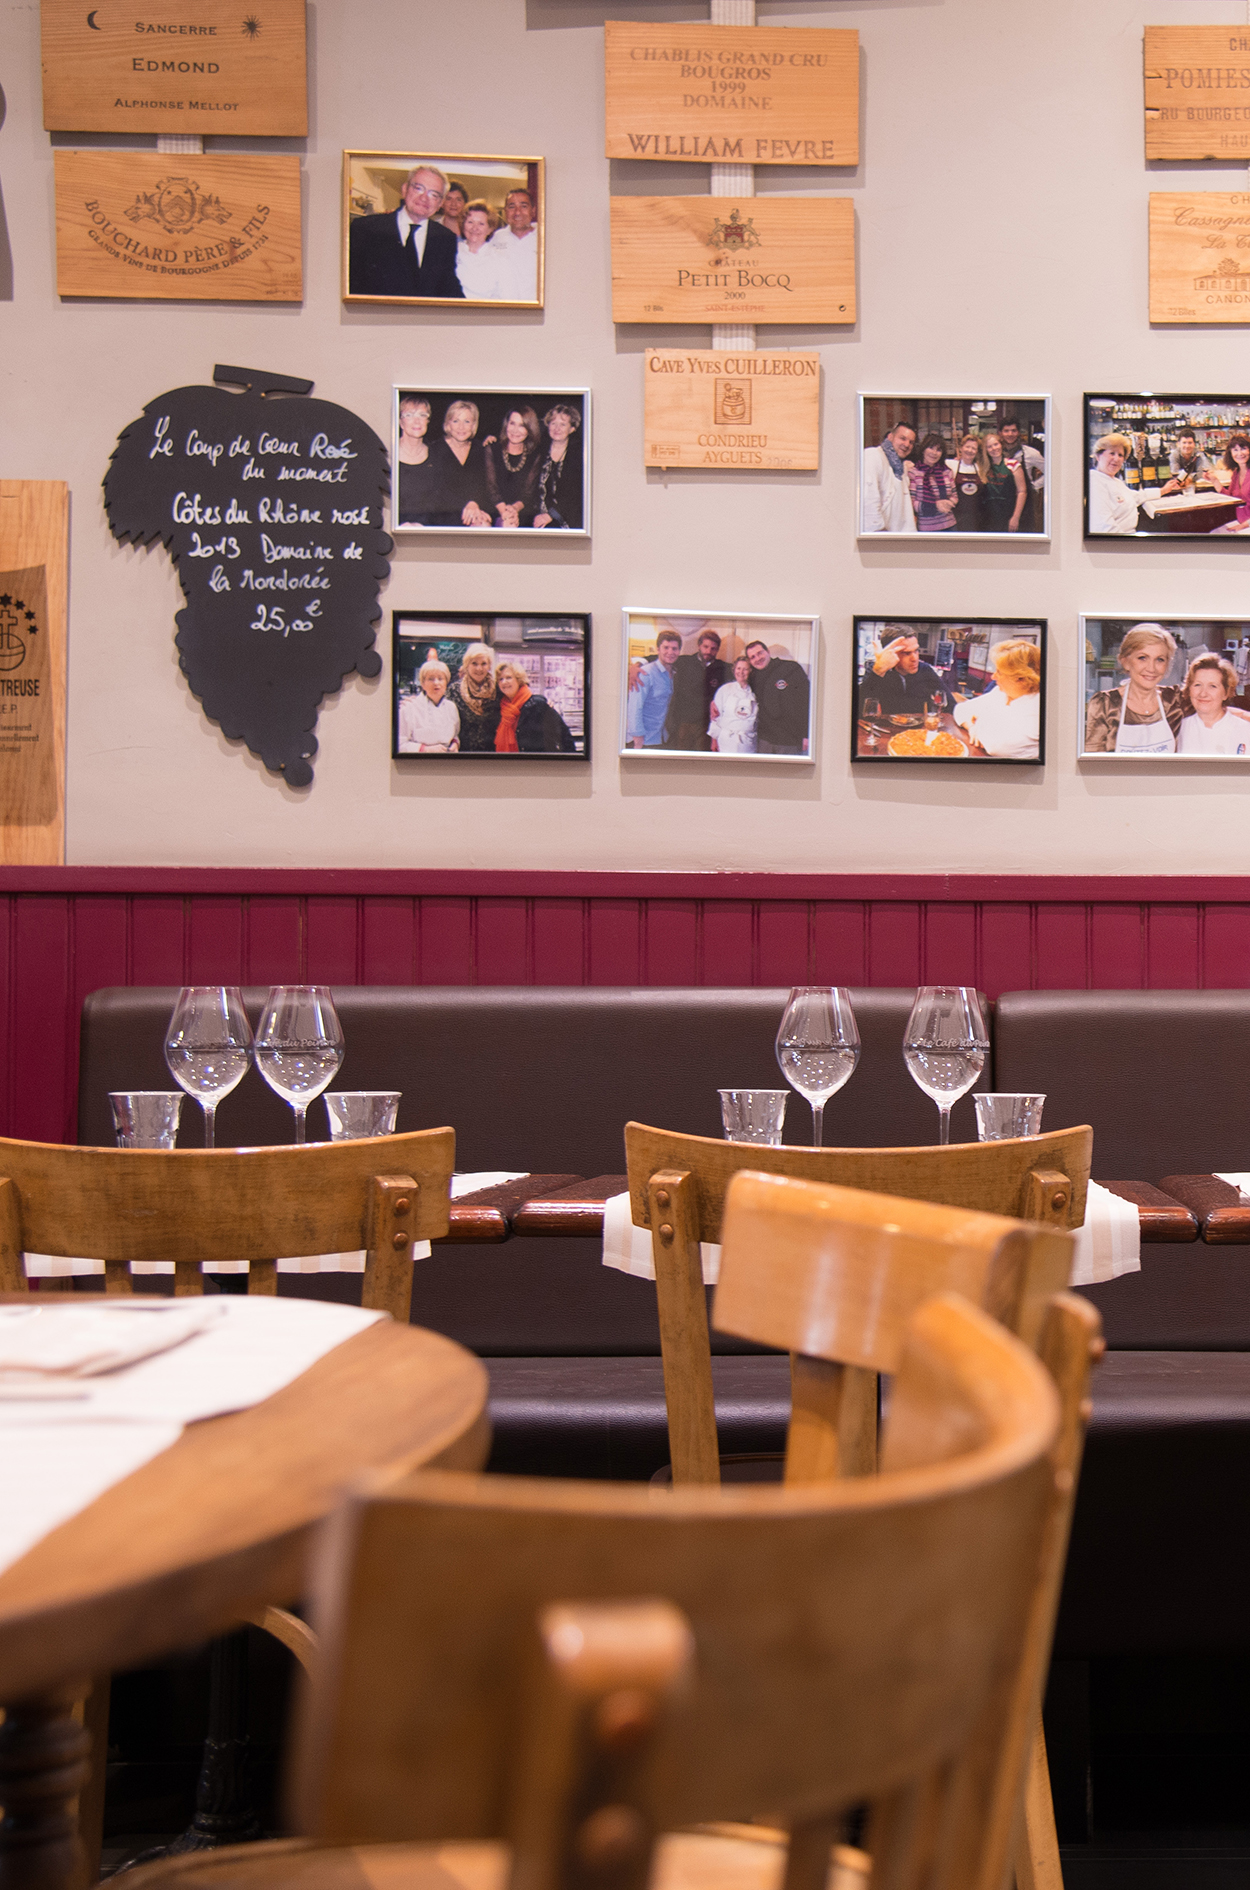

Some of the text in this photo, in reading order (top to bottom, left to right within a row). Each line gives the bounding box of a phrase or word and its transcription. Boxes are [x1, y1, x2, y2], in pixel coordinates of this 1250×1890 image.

[135, 22, 217, 36] SANCERRE
[630, 47, 828, 67] CHABLIS GRAND CRU
[132, 58, 220, 74] EDMOND
[680, 65, 771, 81] BOUGROS
[710, 81, 746, 94] 1999
[114, 98, 239, 112] ALPHONSE MELLOT
[683, 95, 773, 110] DOMAINE
[627, 133, 834, 160] WILLIAM FEVRE
[1173, 206, 1250, 231] Cassagne
[85, 200, 270, 263] BOUCHARD PÈRE & FILS
[1201, 234, 1227, 250] La
[160, 263, 221, 275] BOURGOGNE
[677, 270, 793, 291] PETIT BOCQ
[724, 291, 746, 300] 2000
[650, 357, 817, 376] CAVE YVES CUILLERON
[150, 416, 174, 459] Le
[185, 430, 224, 466] Coup
[229, 435, 250, 457] de
[698, 434, 768, 448] CONDRIEU
[702, 450, 763, 464] AYGUETS
[242, 458, 348, 483] du moment
[172, 491, 221, 525] Côtes
[225, 499, 252, 524] du
[259, 497, 323, 524] Rhône
[188, 532, 363, 563] 2013 Domaine de
[209, 565, 231, 592] la
